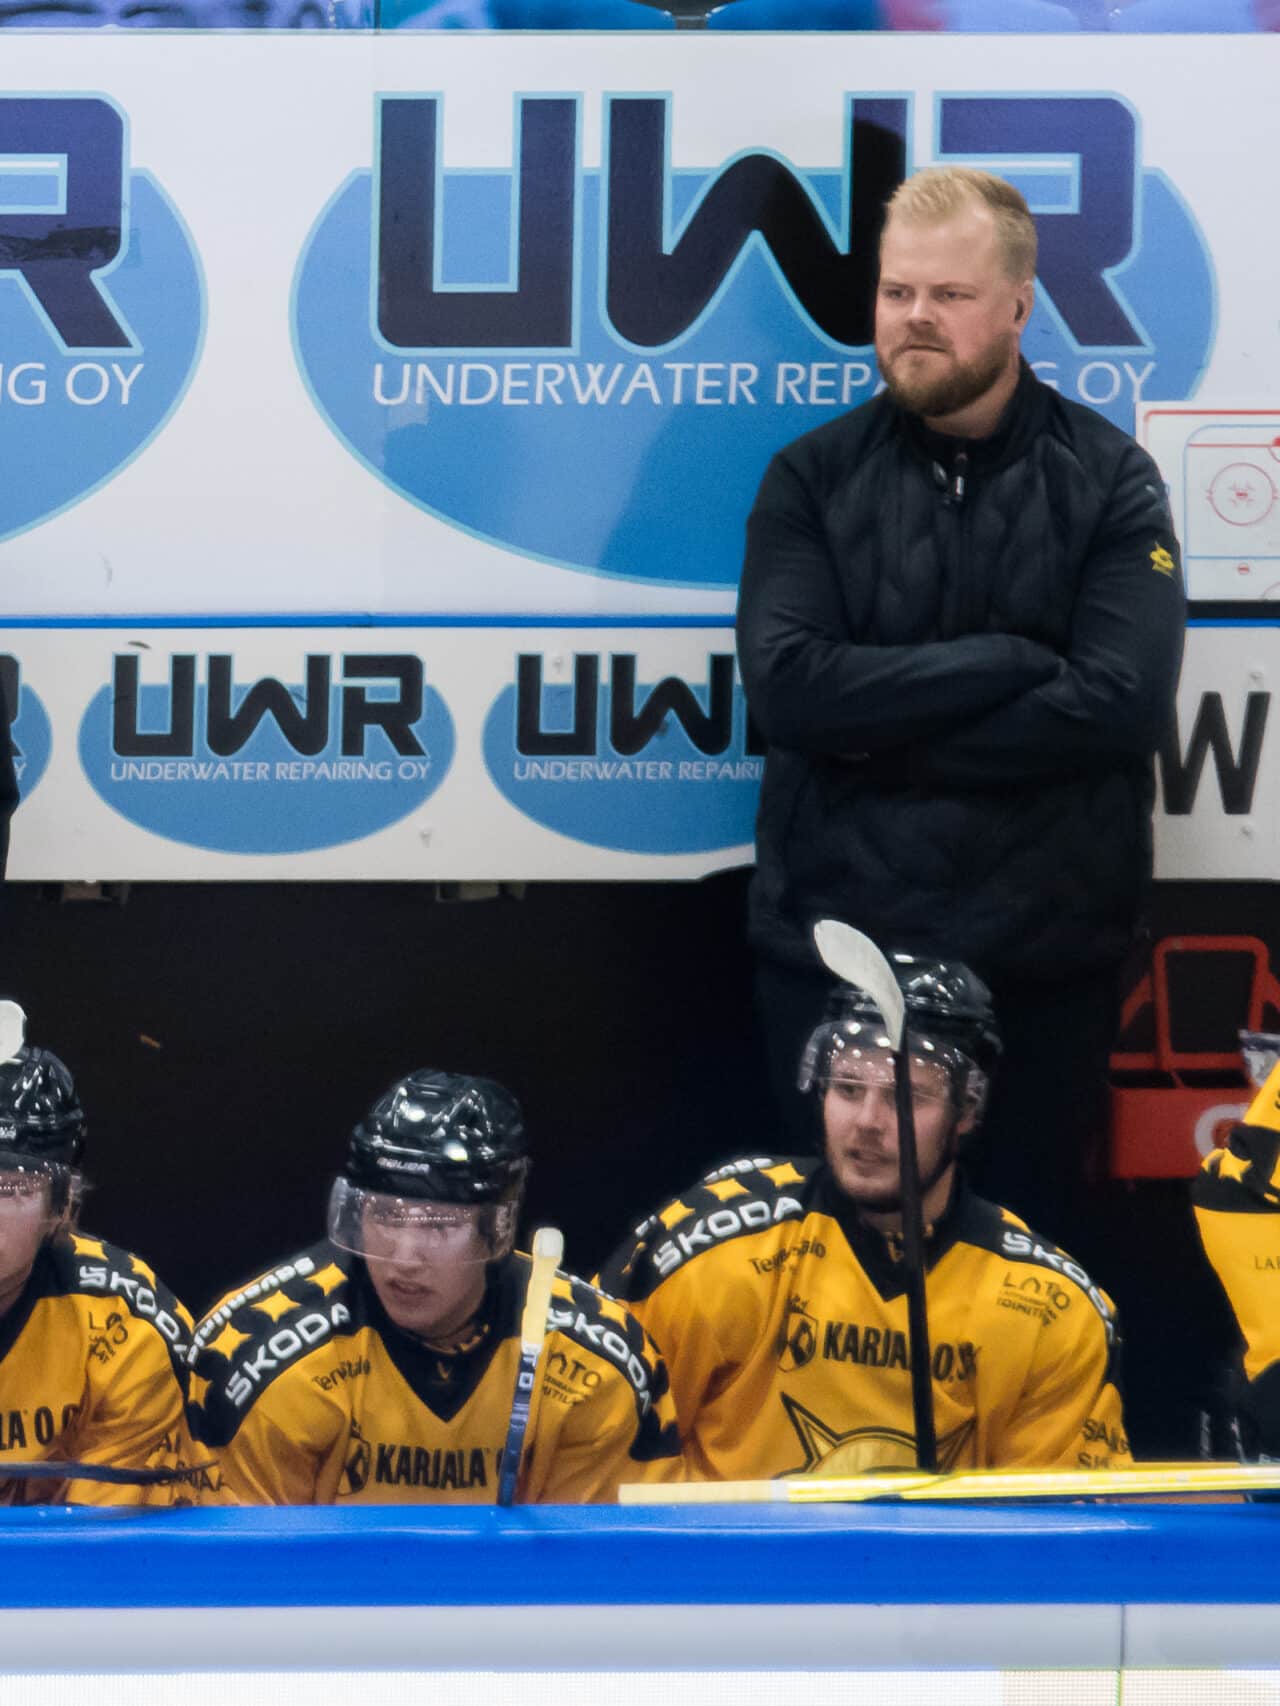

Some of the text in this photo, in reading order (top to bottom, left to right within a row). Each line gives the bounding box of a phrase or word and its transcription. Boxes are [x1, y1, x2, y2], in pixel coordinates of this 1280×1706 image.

[372, 90, 1157, 356] UWR
[65, 362, 144, 406] OY
[373, 362, 759, 406] UNDERWATER
[1077, 361, 1156, 404] OY
[112, 653, 427, 757] UWR
[516, 652, 766, 757] UW
[111, 761, 431, 781] UNDERWATER REPAIRING OY
[513, 760, 763, 781] UNDERWATER REPAIRI
[822, 1320, 912, 1371] KARJA
[375, 1442, 488, 1490] KARJALA
